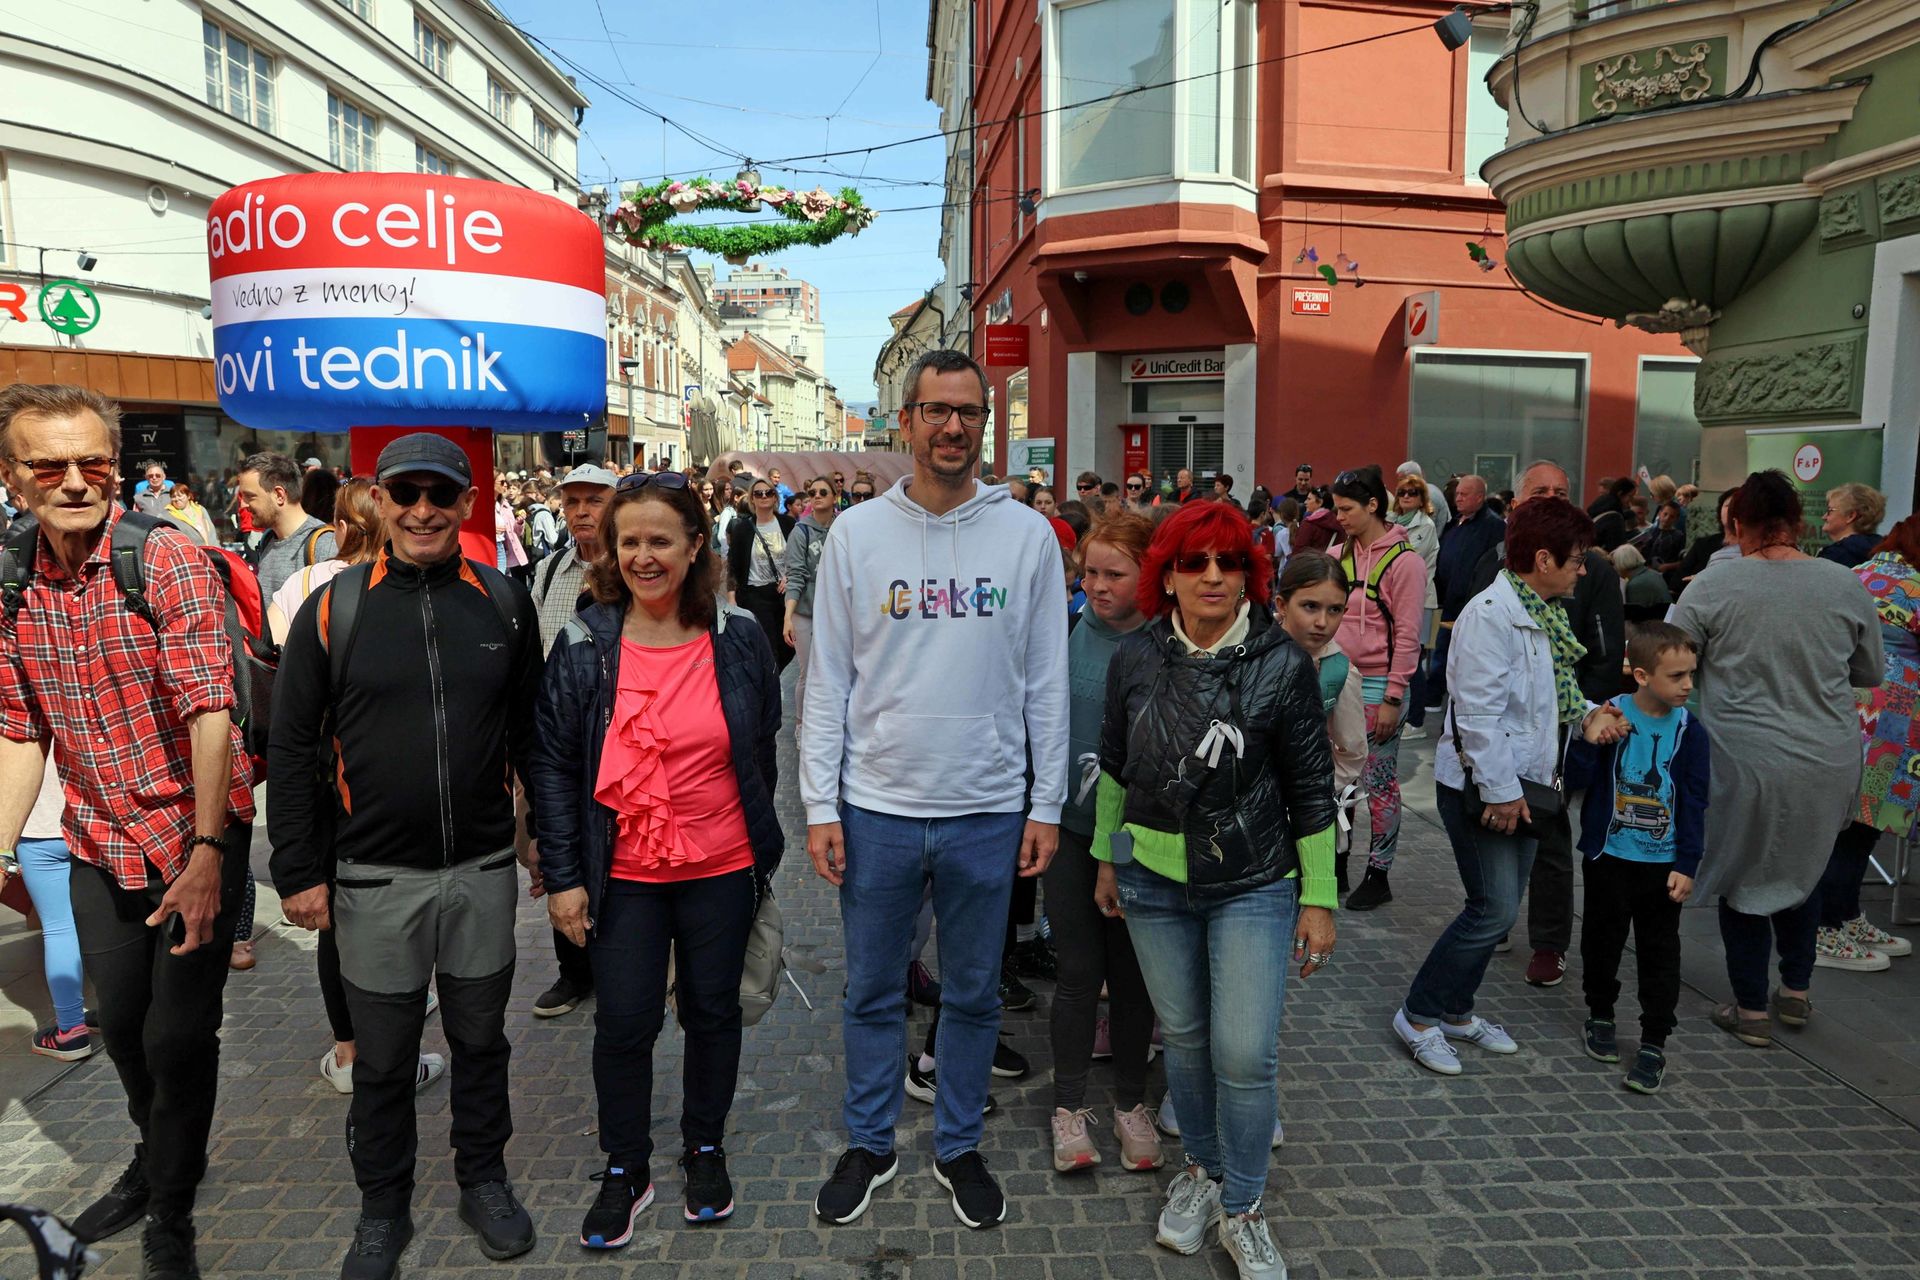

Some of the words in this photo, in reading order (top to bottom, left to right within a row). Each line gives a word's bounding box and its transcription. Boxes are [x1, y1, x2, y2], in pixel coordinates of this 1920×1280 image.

[208, 192, 307, 259] adio
[332, 189, 503, 265] celje
[322, 277, 416, 316] menoj!
[1302, 302, 1321, 311] ULICA
[292, 328, 508, 392] tednik
[1150, 360, 1202, 374] UniCredit
[141, 430, 157, 443] TV
